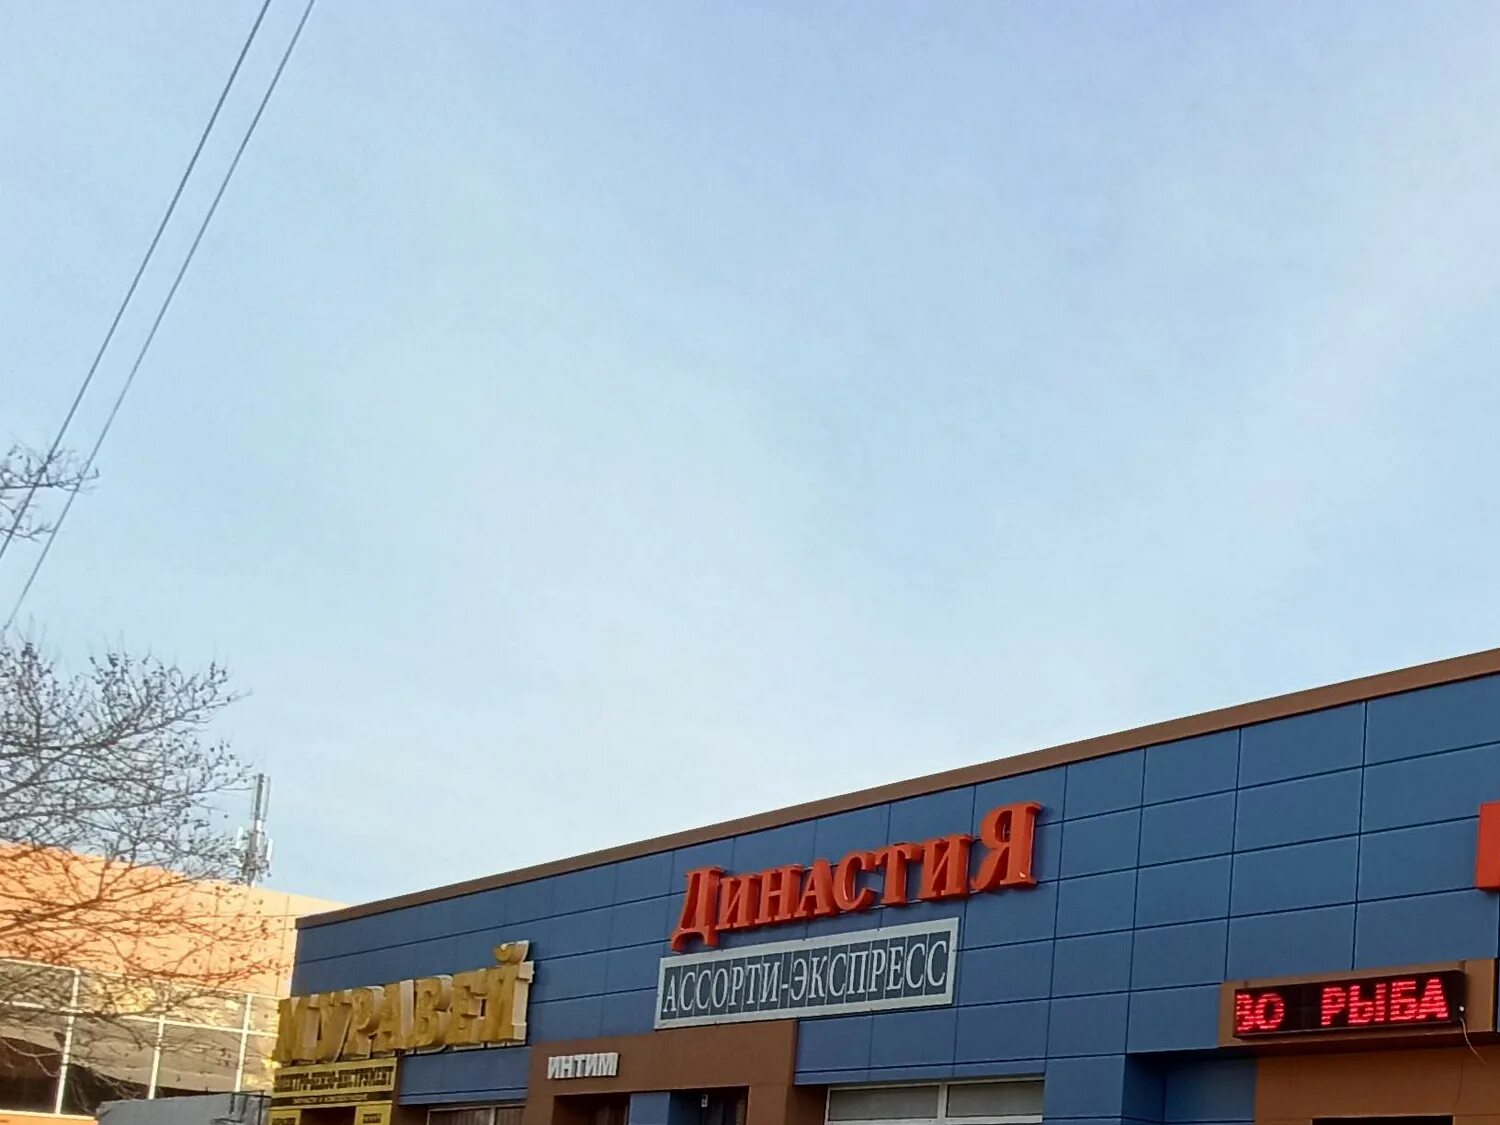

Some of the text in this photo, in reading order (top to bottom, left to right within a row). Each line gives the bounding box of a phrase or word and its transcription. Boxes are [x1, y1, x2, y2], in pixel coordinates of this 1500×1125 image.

[670, 801, 1042, 953] ДИНАСТИЯ
[271, 940, 534, 1063] МУРАВЕЙ
[662, 940, 948, 1012] АССОРТИ-ЭКСПРЕСС
[1321, 978, 1449, 1026] РЫБА
[547, 1052, 619, 1080] ИНТИМ
